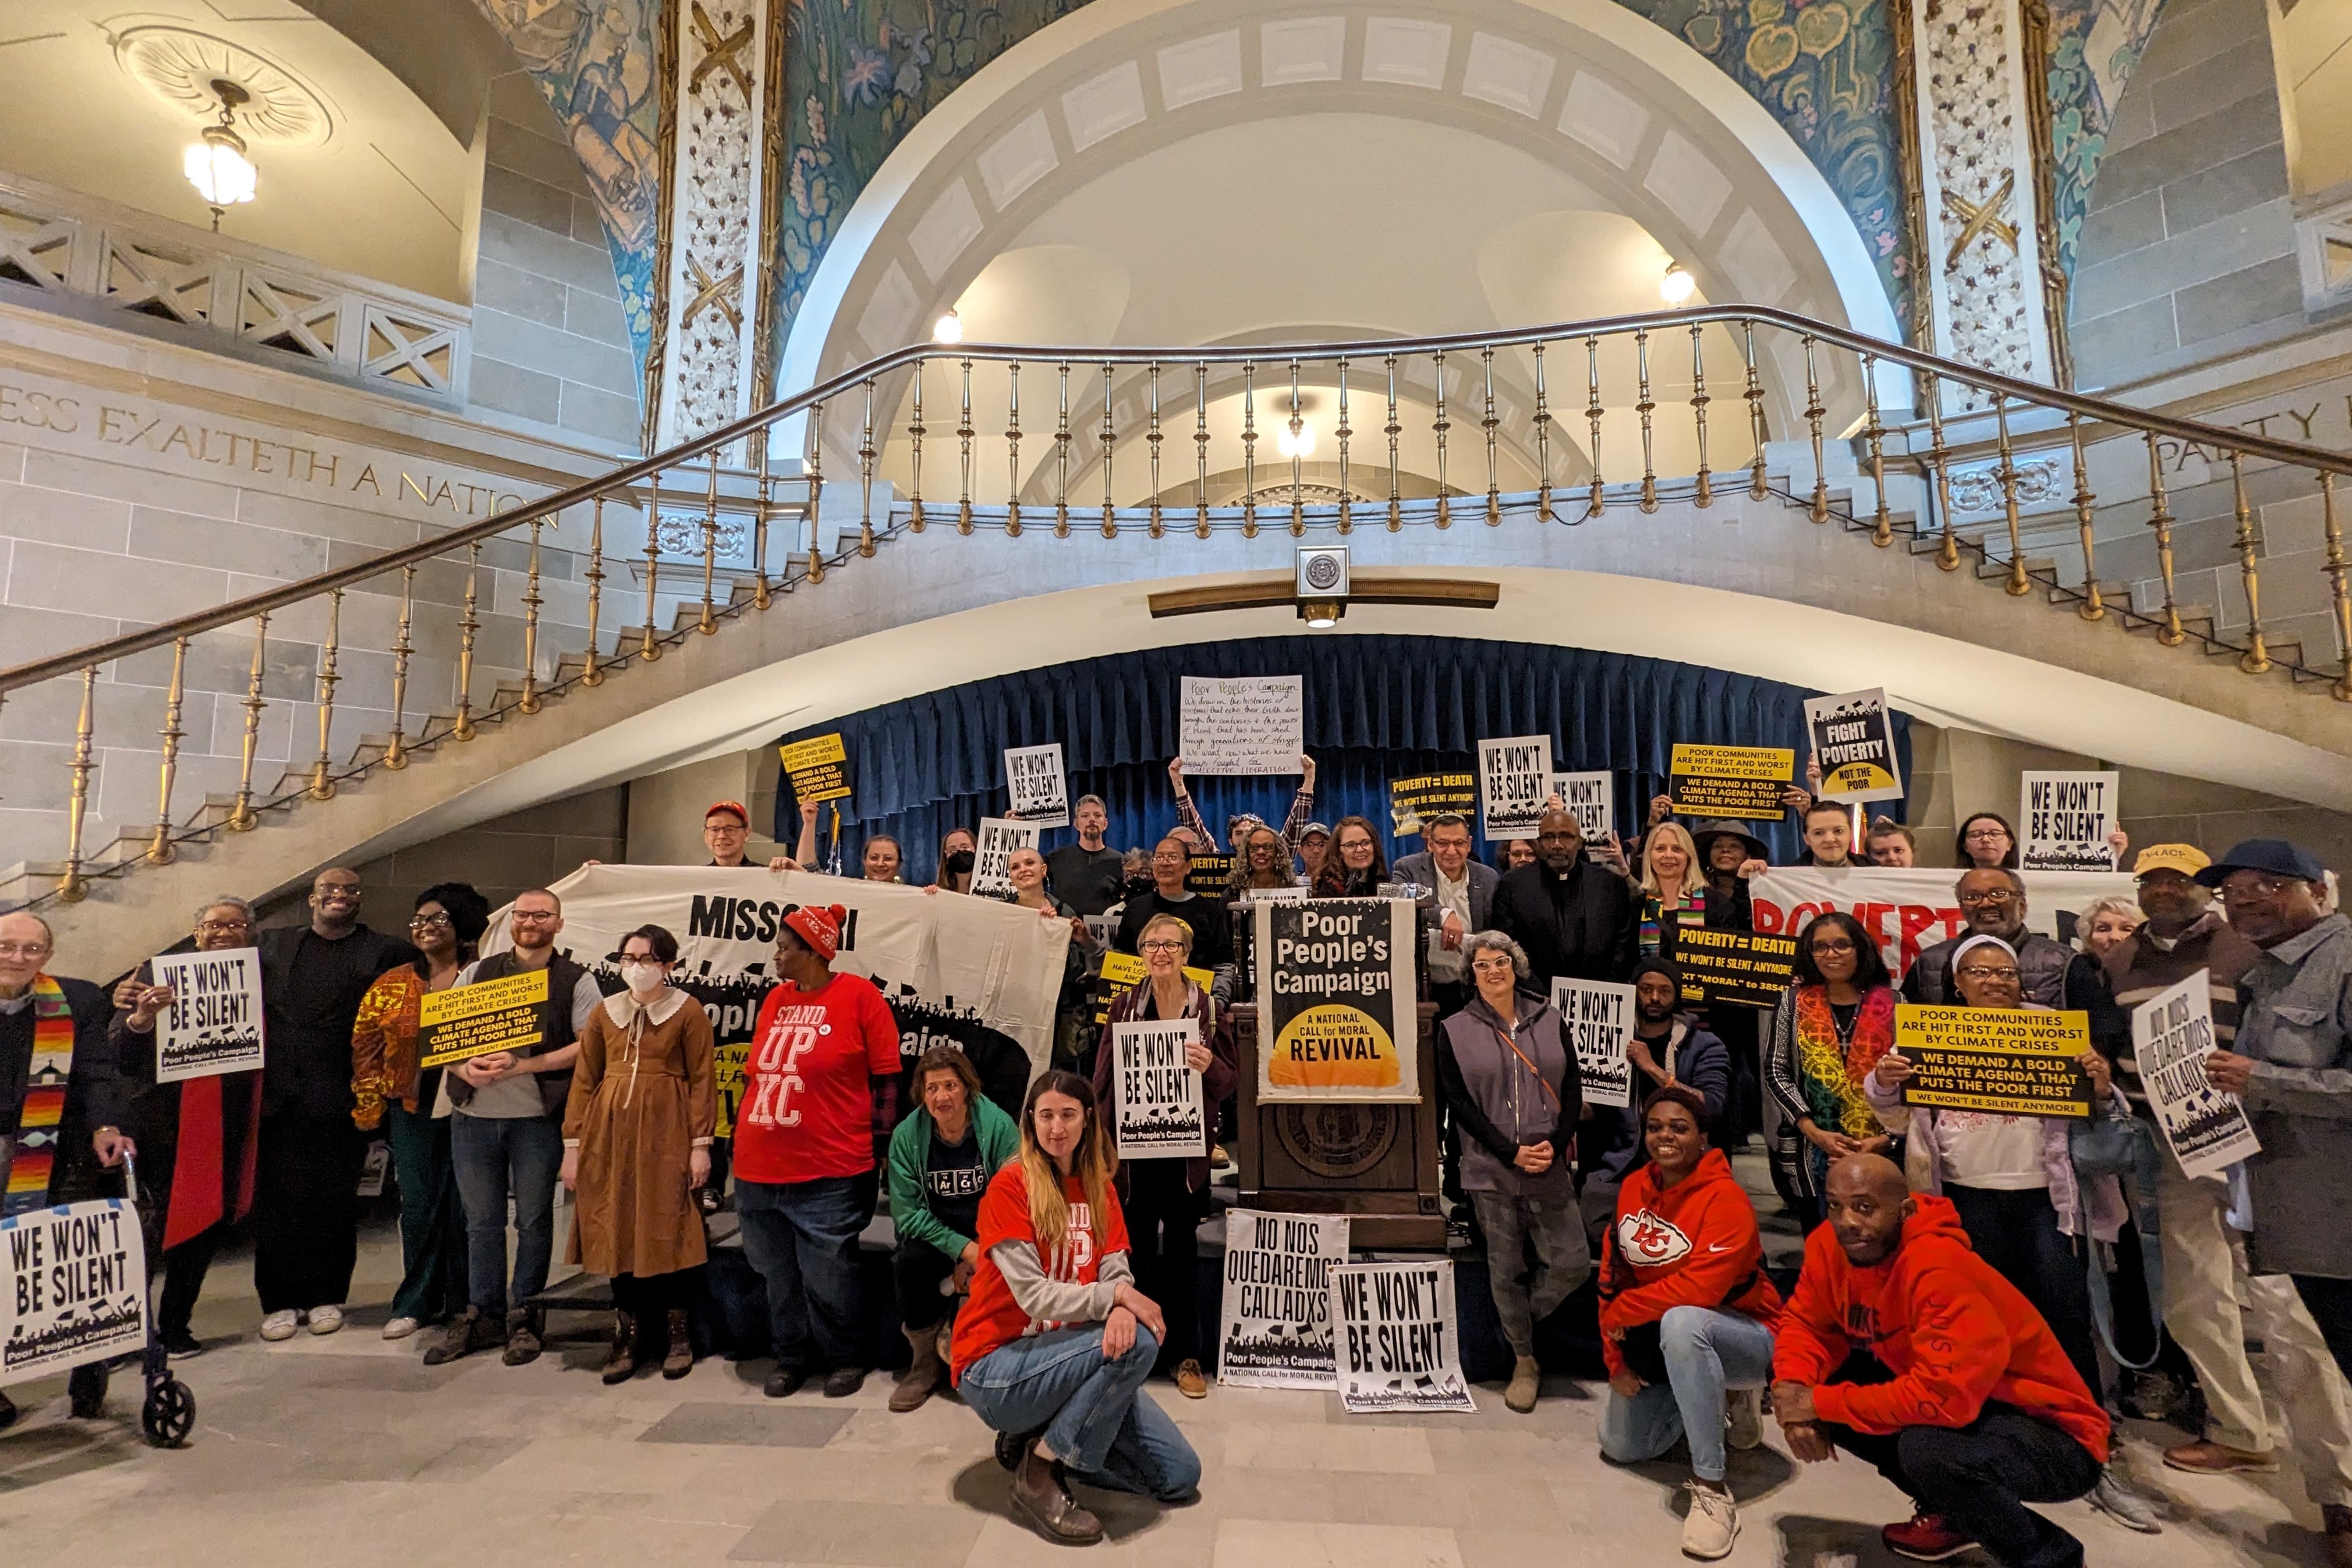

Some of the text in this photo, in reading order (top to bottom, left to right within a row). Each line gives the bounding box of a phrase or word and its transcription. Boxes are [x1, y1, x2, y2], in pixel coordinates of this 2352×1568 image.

[98, 406, 342, 487] EXALTETH
[352, 464, 381, 496] A
[2158, 403, 2321, 475] PATY
[1191, 679, 1298, 698] Poor People's Campaign
[1216, 725, 1232, 733] that
[1236, 725, 1247, 733] has
[1271, 725, 1290, 733] shed
[1827, 721, 1866, 743] FIGHT
[1182, 735, 1205, 750] through
[1258, 735, 1271, 743] of
[1271, 735, 1301, 747] struggle
[1821, 740, 1883, 765] POVERTY
[1011, 753, 1054, 777] WE WON'T
[1486, 745, 1540, 774] WE WON'T
[1717, 750, 1777, 760] COMMUNITIES
[1705, 767, 1740, 775] CLIMATE
[1839, 767, 1872, 780] NOT THE
[1015, 775, 1058, 799] BE SILENT
[1490, 773, 1543, 801] BE SILENT
[1847, 779, 1870, 790] POOR
[2031, 782, 2103, 810] WE WON'T
[2032, 812, 2104, 842] BE SILENT
[2146, 849, 2185, 857] NAACP
[689, 895, 858, 952] MISSI
[1302, 911, 1362, 937] Poor
[1277, 935, 1387, 969] People's
[1751, 937, 1796, 955] DEATH
[1113, 963, 1131, 973] HAVE
[1676, 952, 1793, 975] WE WON'T BE SILENT ANYMORE
[164, 960, 245, 996] WE WON'T
[439, 977, 530, 1002] POOR COMMUNITIES
[1274, 967, 1390, 998] Campaign
[1697, 974, 1744, 986] "MORAL"
[425, 982, 544, 1013] ARE HIT FIRST AND WORST
[442, 995, 527, 1019] BY CLIMATE CRISES
[171, 992, 249, 1031] BE SILENT
[774, 1005, 827, 1027] STAND
[1308, 1013, 1359, 1024] A NATIONAL
[1920, 1010, 2063, 1026] POOR COMMUNITIES
[1299, 1026, 1370, 1036] CALL for MORAL
[1902, 1021, 2084, 1039] ARE HIT FIRST AND WORST
[757, 1026, 817, 1073] UP
[1121, 1032, 1186, 1068] WE WON'T
[1291, 1037, 1380, 1061] REVIVAL
[1926, 1034, 2059, 1051] BY CLIMATE CRISES
[1922, 1052, 2066, 1071] WE DEMAND A BOLD
[1125, 1068, 1190, 1104] BE SILENT
[1913, 1064, 2078, 1084] CLIMATE AGENDA THAT
[1919, 1077, 2073, 1097] PUTS THE POOR FIRST
[748, 1073, 805, 1127] KC
[1935, 1095, 1968, 1105] WON'T
[1986, 1099, 2020, 1109] SILENT
[2022, 1102, 2076, 1112] ANYMORE
[1138, 1131, 1165, 1140] People's
[1167, 1130, 1199, 1140] Campaign
[10, 1211, 120, 1272] WE WON'T
[1255, 1217, 1319, 1255] NO NOS
[1630, 1222, 1671, 1258] KC
[1228, 1250, 1343, 1289] QUEDAREMO
[16, 1251, 126, 1317] BE SILENT
[1339, 1271, 1438, 1321] WE WON'T
[1241, 1285, 1327, 1323] CALLADXS
[1227, 1352, 1248, 1363] Poor
[1249, 1353, 1288, 1367] People's
[1347, 1322, 1443, 1373] BE SILENT
[1290, 1372, 1313, 1380] MORAL
[1315, 1373, 1337, 1381] REVIVA
